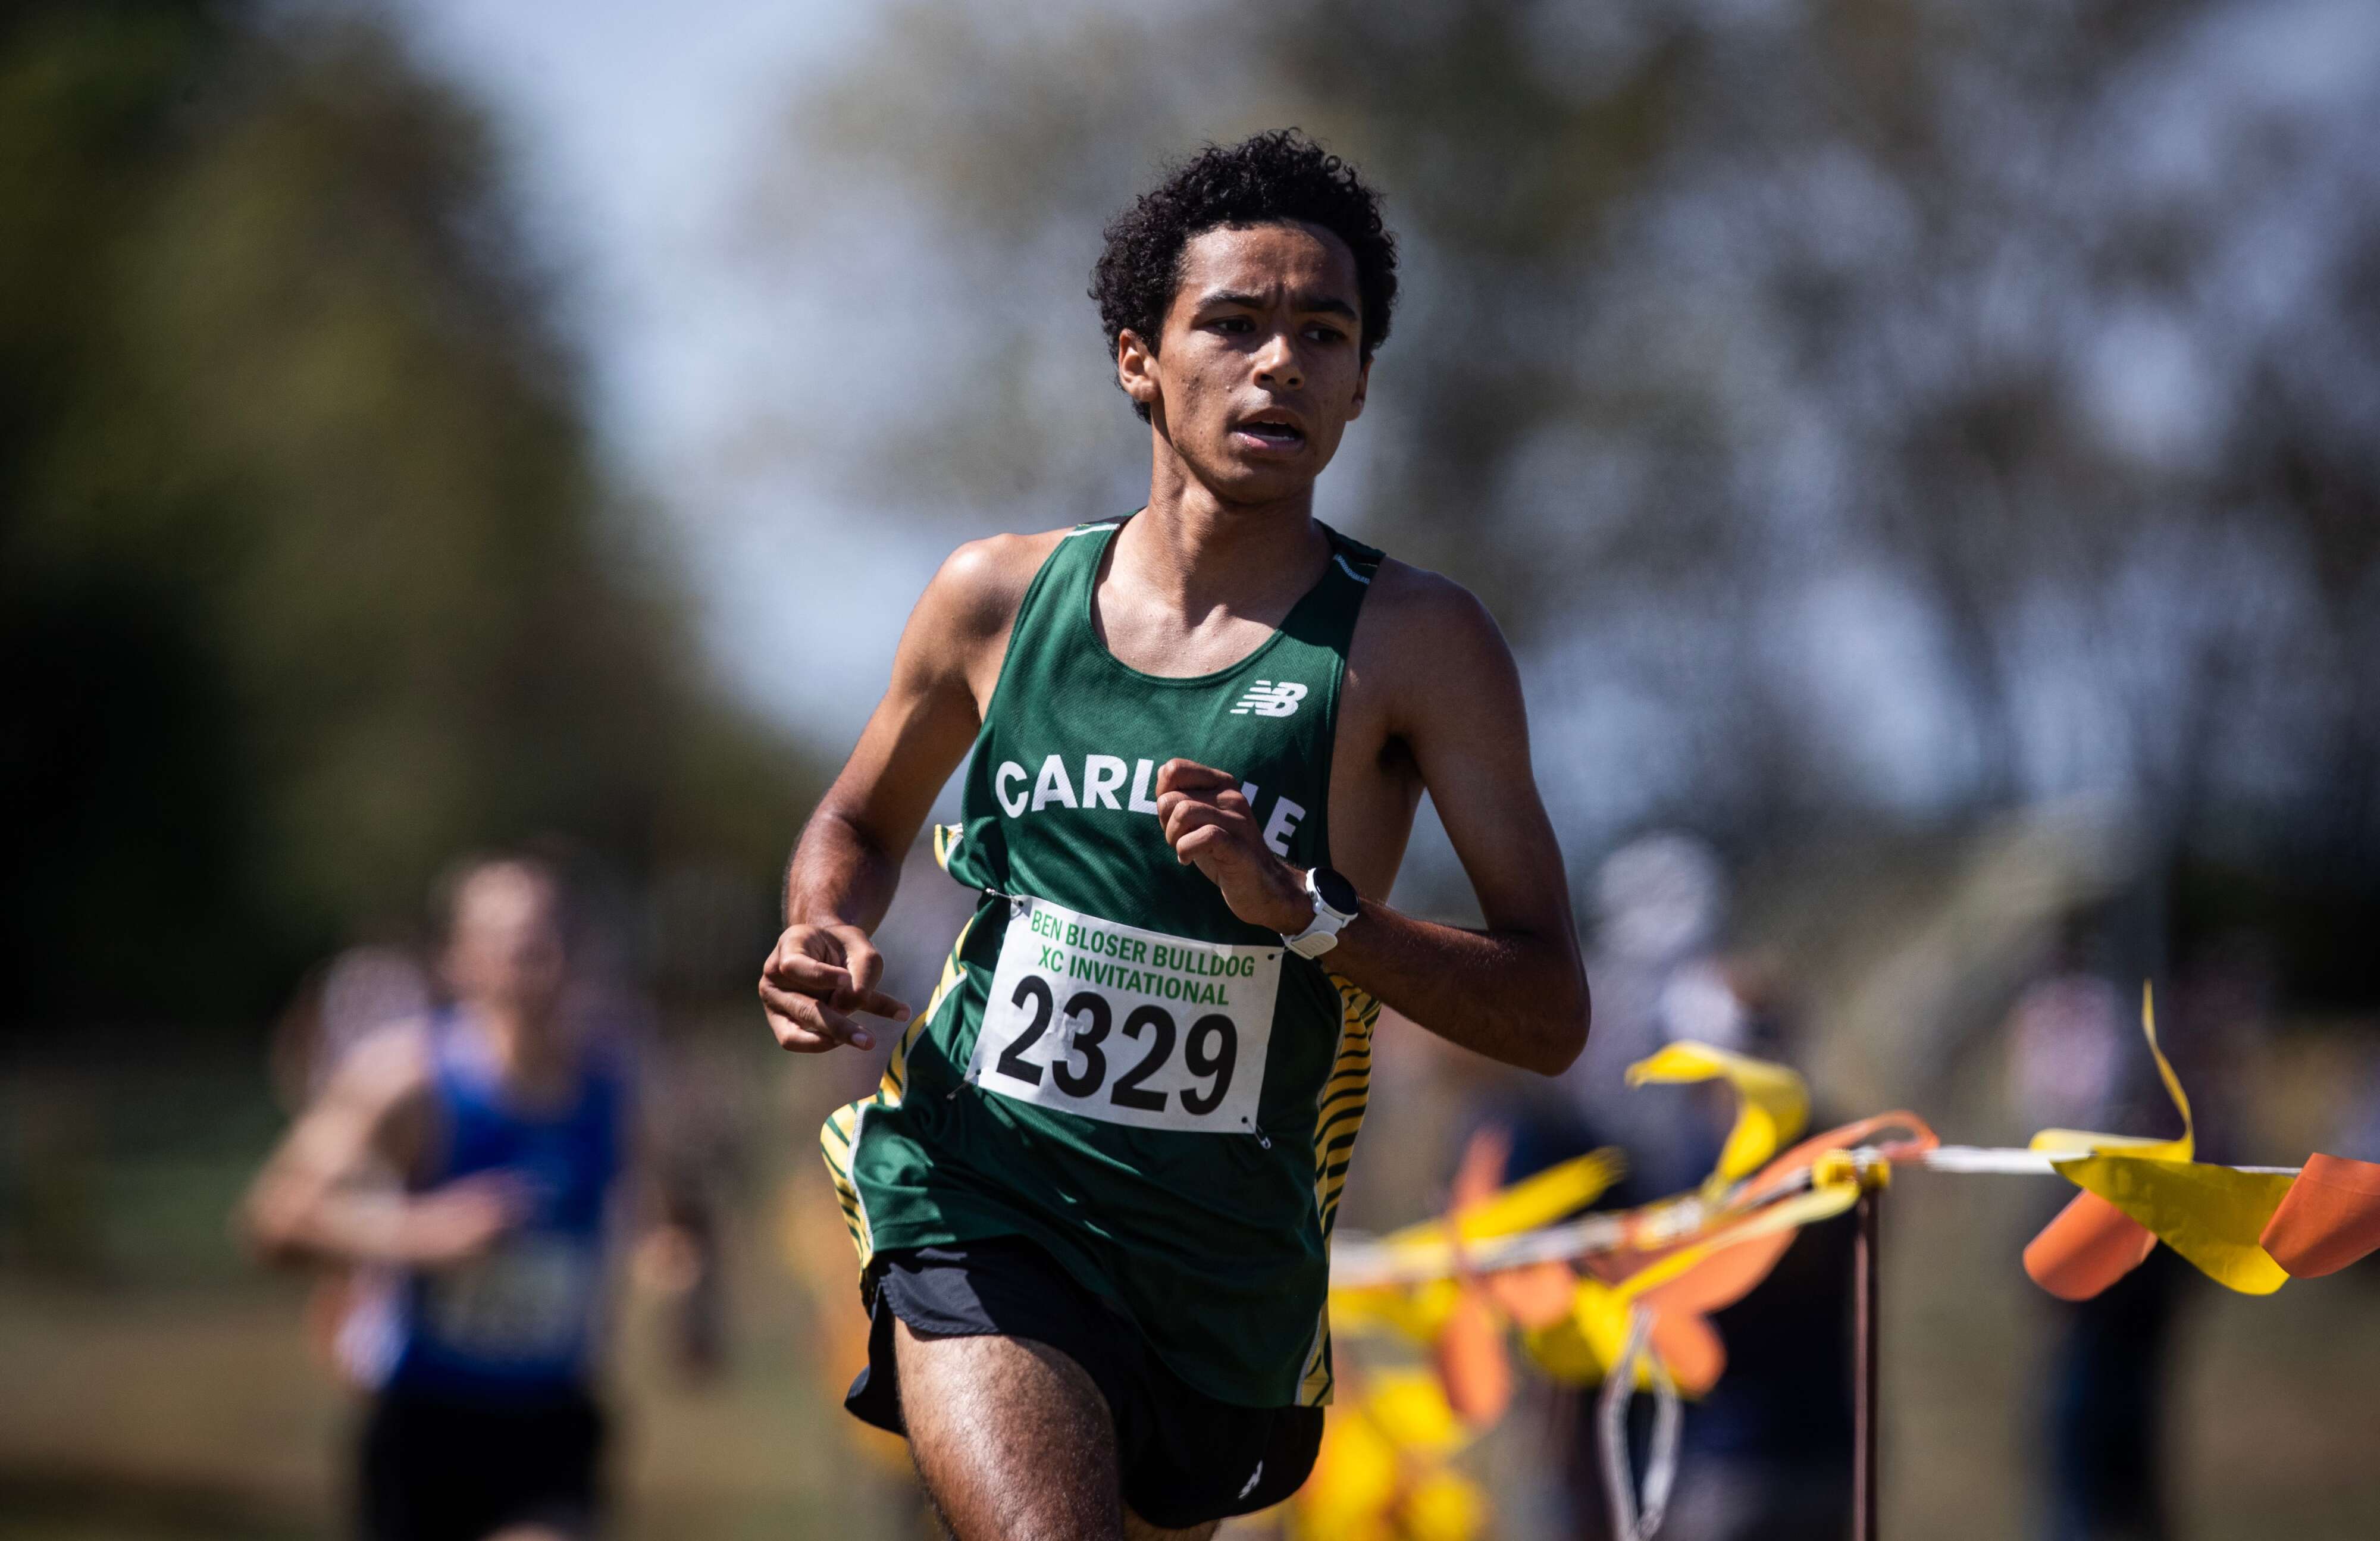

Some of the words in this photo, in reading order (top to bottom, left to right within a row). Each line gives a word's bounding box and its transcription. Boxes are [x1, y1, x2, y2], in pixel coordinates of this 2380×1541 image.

[1230, 680, 1308, 717] NB
[995, 754, 1307, 857] CARLE
[1031, 910, 1062, 941] BEN
[1066, 924, 1147, 963] BLOSER
[1152, 947, 1255, 977] BULLDOG
[1038, 945, 1064, 972] XC
[1070, 958, 1229, 1006] INVITATIONAL
[996, 975, 1238, 1116] 2329
